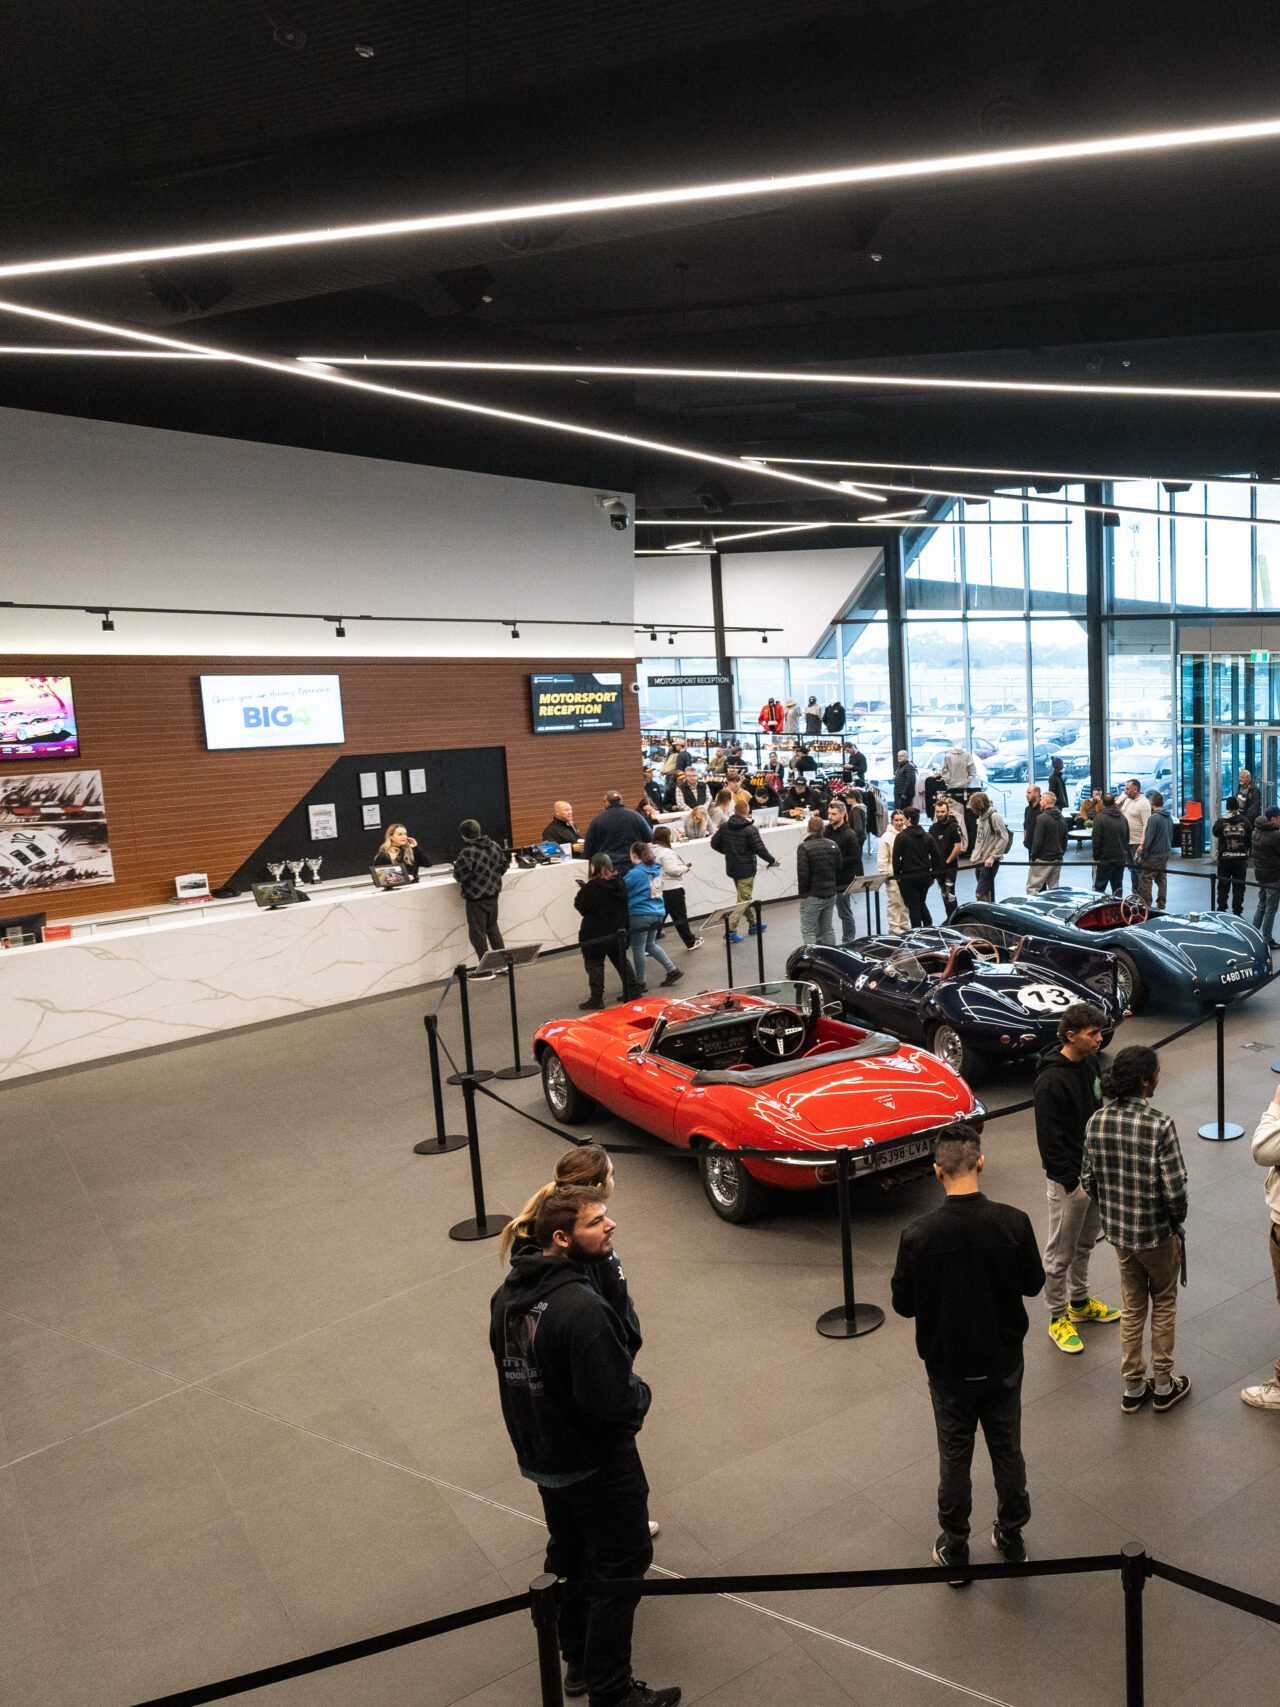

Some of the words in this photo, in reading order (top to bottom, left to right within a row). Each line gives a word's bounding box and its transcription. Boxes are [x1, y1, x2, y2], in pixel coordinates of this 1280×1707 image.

[654, 677, 696, 686] MOTORSPORT
[697, 676, 729, 684] RECEPTION
[539, 692, 618, 704] MOTORSPORT
[539, 704, 602, 716] RECEPTION
[1220, 970, 1240, 985] C480
[1240, 967, 1254, 980] TVV
[1027, 987, 1072, 1006] 13
